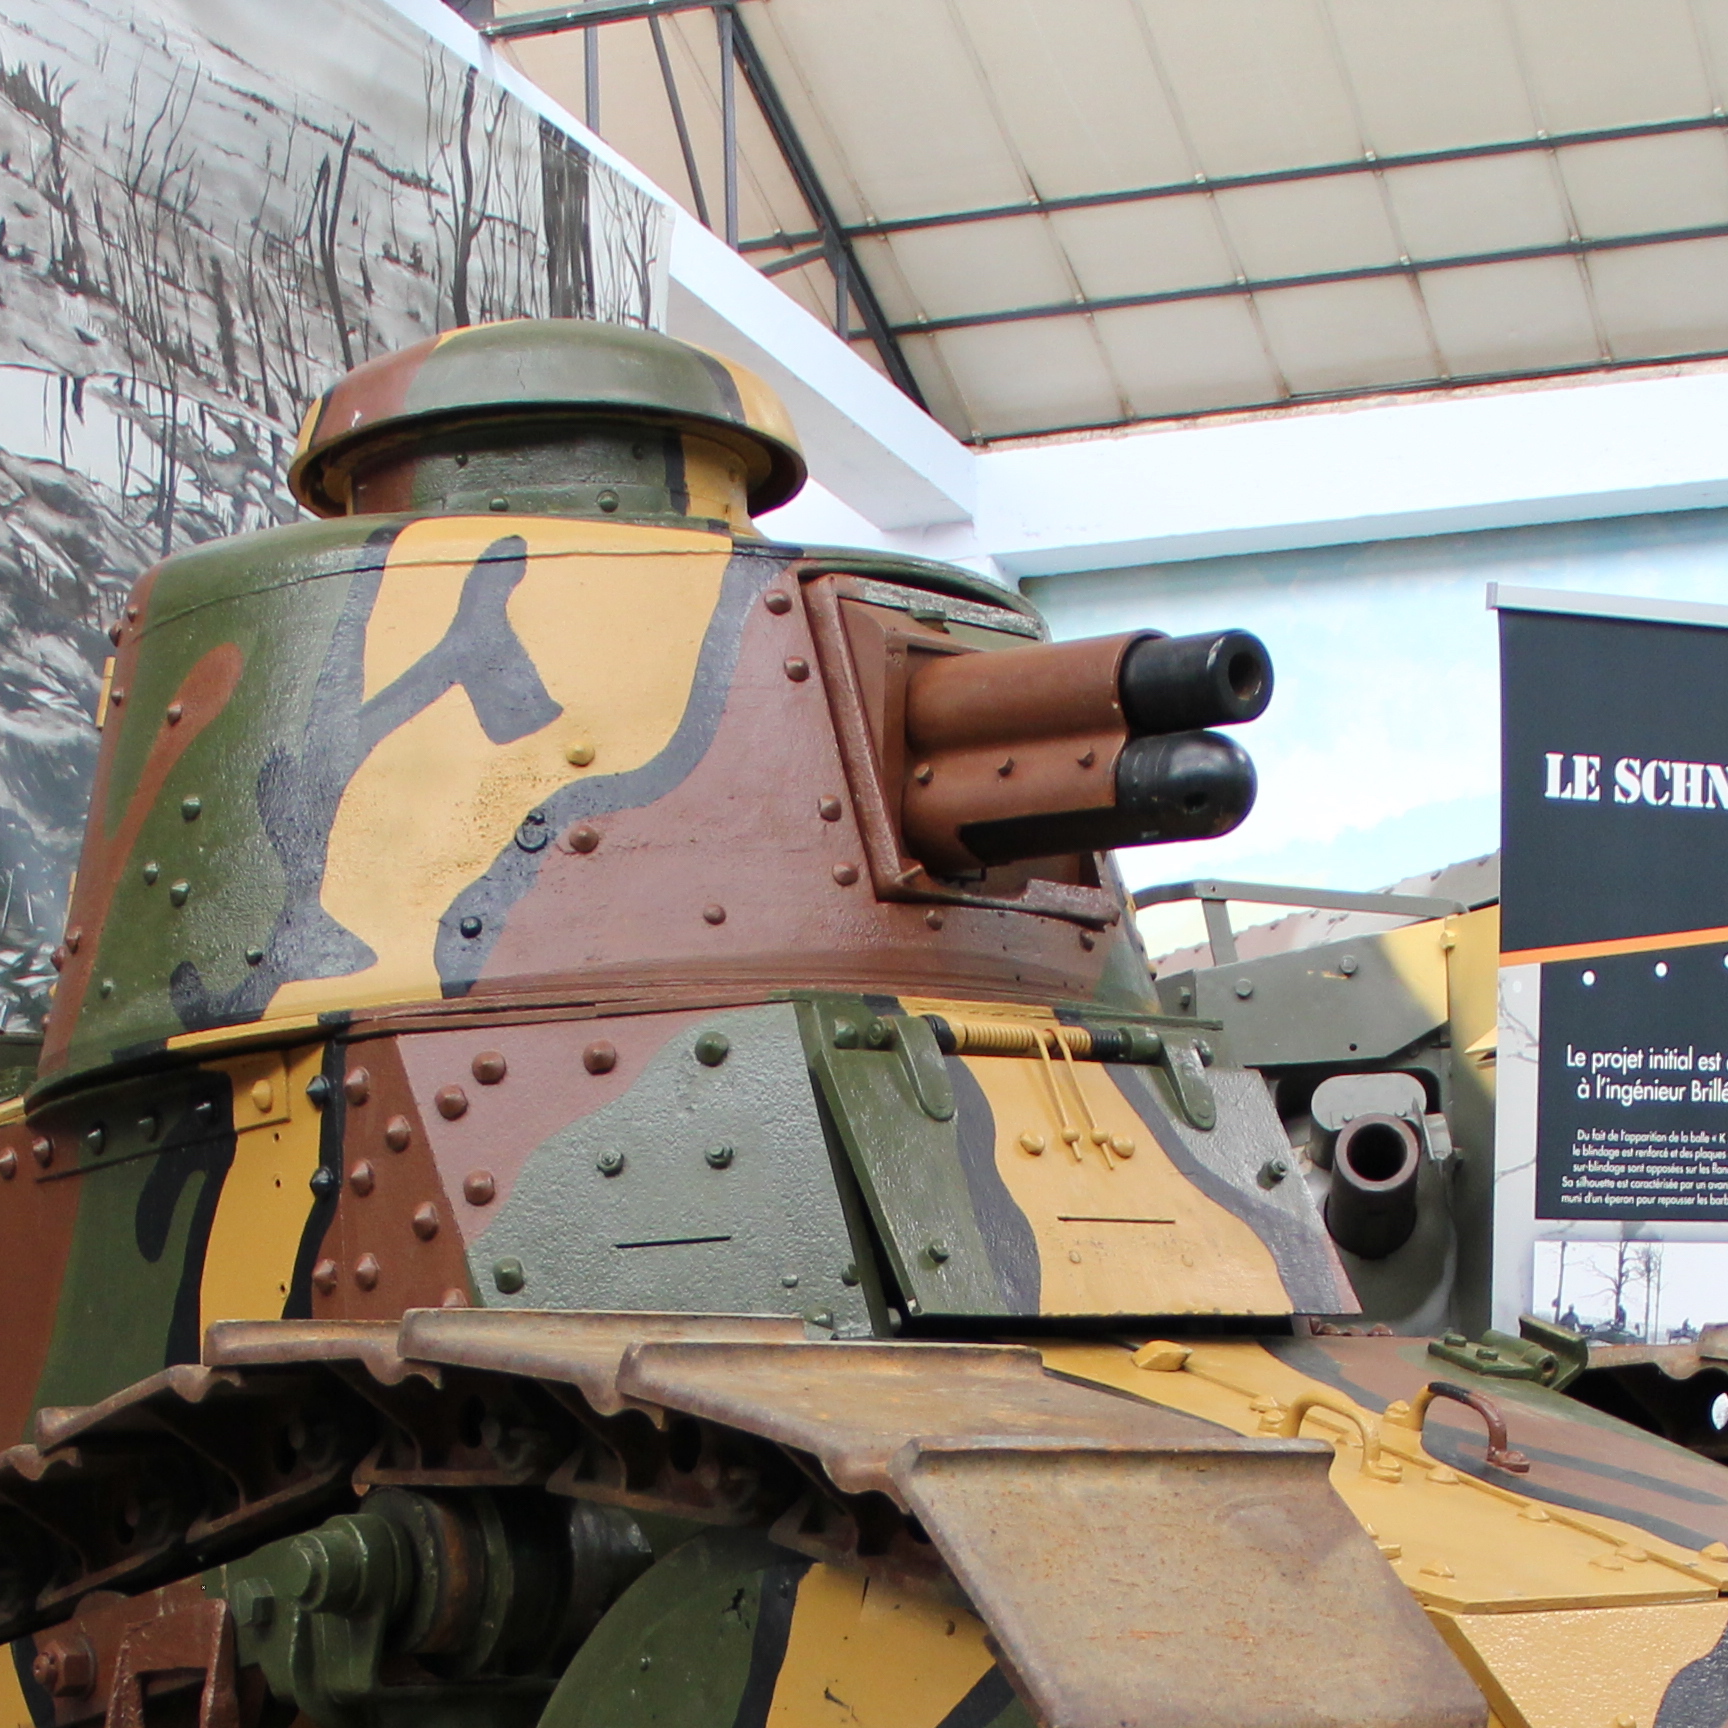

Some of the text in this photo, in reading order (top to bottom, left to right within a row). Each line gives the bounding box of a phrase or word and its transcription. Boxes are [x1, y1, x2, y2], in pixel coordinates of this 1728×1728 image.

[1544, 752, 1601, 801] LE
[1567, 1044, 1586, 1067] Le
[1592, 1047, 1644, 1075] projet
[1649, 1045, 1693, 1070] initial
[1698, 1052, 1721, 1071] est
[1578, 1077, 1589, 1098] à
[1597, 1074, 1686, 1106] l'ingénieur
[1577, 1129, 1589, 1140] Du
[1592, 1128, 1606, 1141] fait
[1608, 1129, 1618, 1141] de
[1621, 1129, 1666, 1144] l'apparition
[1669, 1131, 1679, 1143] de
[1681, 1131, 1688, 1143] la
[1691, 1132, 1709, 1143] balle
[1719, 1133, 1725, 1143] K
[1573, 1144, 1580, 1156] le
[1583, 1144, 1619, 1159] blindage
[1622, 1148, 1633, 1157] est
[1636, 1146, 1668, 1158] renforcé
[1671, 1149, 1678, 1158] et
[1680, 1149, 1693, 1159] des
[1695, 1147, 1726, 1161] plaques
[1573, 1161, 1625, 1174] sur-blindage
[1628, 1164, 1644, 1173] sont
[1646, 1162, 1683, 1176] apposées
[1686, 1166, 1697, 1174] sur
[1699, 1162, 1710, 1174] les
[1562, 1176, 1573, 1188] Sa
[1576, 1177, 1614, 1188] silhouette
[1617, 1180, 1628, 1188] est
[1631, 1178, 1678, 1189] caractérisée
[1680, 1182, 1693, 1191] par
[1562, 1193, 1582, 1203] muni
[1585, 1193, 1602, 1203] d'un
[1605, 1193, 1634, 1206] éperon
[1637, 1195, 1655, 1206] pour
[1658, 1195, 1695, 1207] repousser
[1697, 1193, 1707, 1205] les
